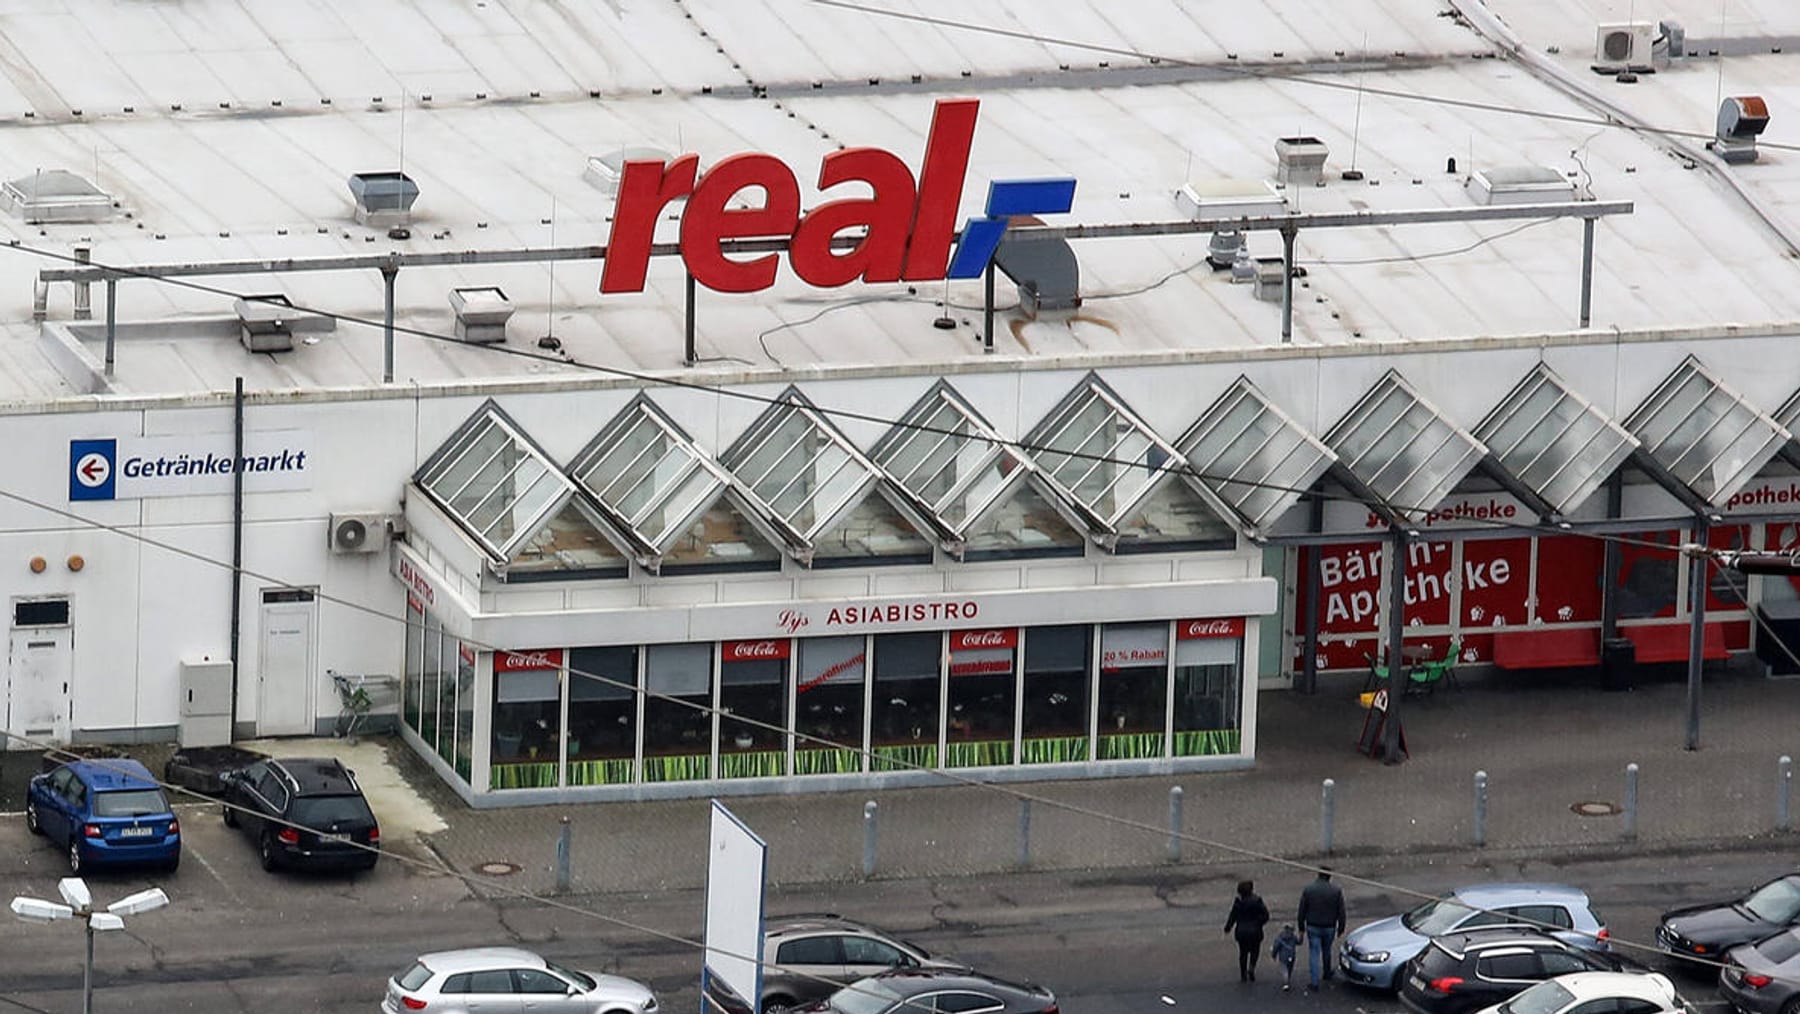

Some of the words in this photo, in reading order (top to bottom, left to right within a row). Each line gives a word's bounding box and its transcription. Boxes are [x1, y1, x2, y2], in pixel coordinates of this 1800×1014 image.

[1422, 499, 1517, 526] potheke
[1320, 541, 1446, 588] Bärn-
[1325, 557, 1510, 624] Apthke
[826, 601, 979, 626] ASIABISTRO
[1119, 650, 1128, 661] %
[1130, 649, 1165, 661] Rabatt
